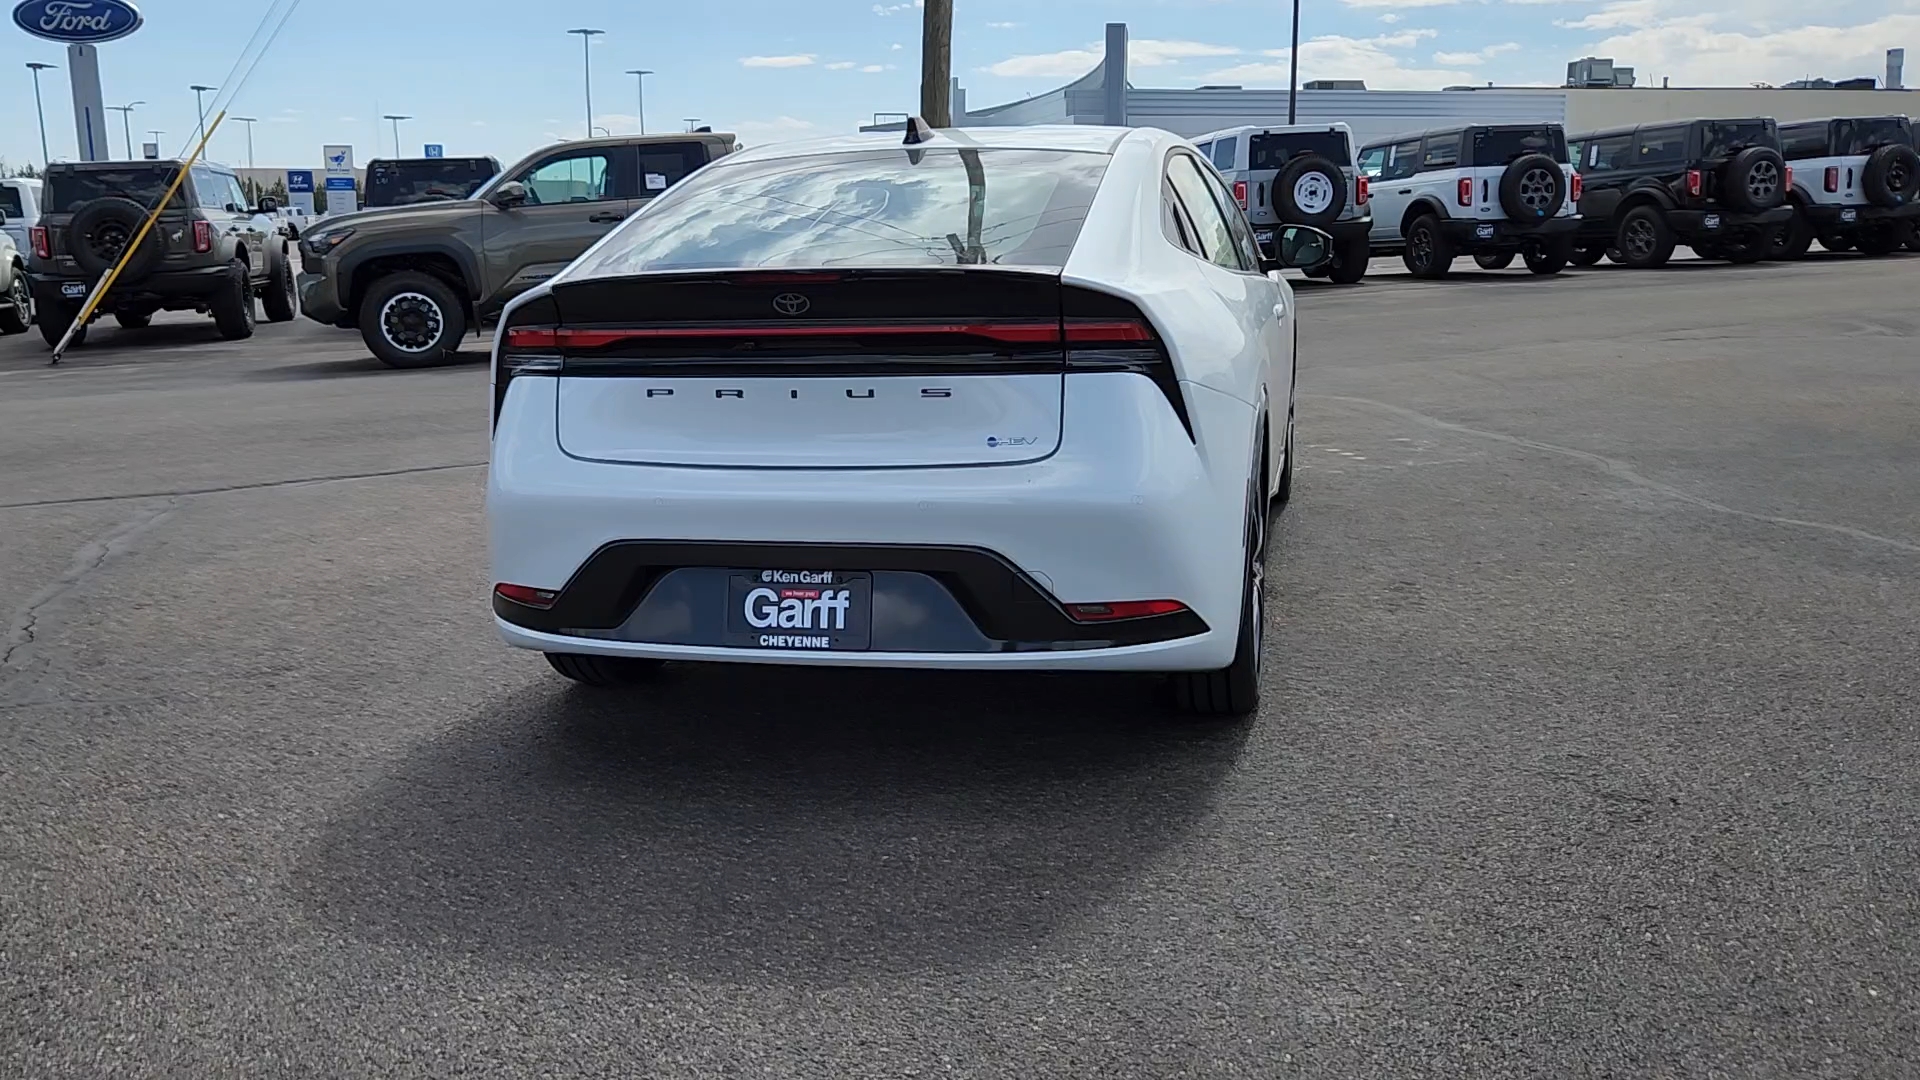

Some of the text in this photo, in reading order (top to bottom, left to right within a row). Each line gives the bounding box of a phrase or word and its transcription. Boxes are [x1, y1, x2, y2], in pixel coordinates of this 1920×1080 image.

[40, 1, 112, 30] Ford
[646, 388, 952, 399] PRIUS
[773, 570, 833, 584] Ken Garff
[744, 587, 850, 630] Garff
[760, 634, 830, 648] CHEYENNE
